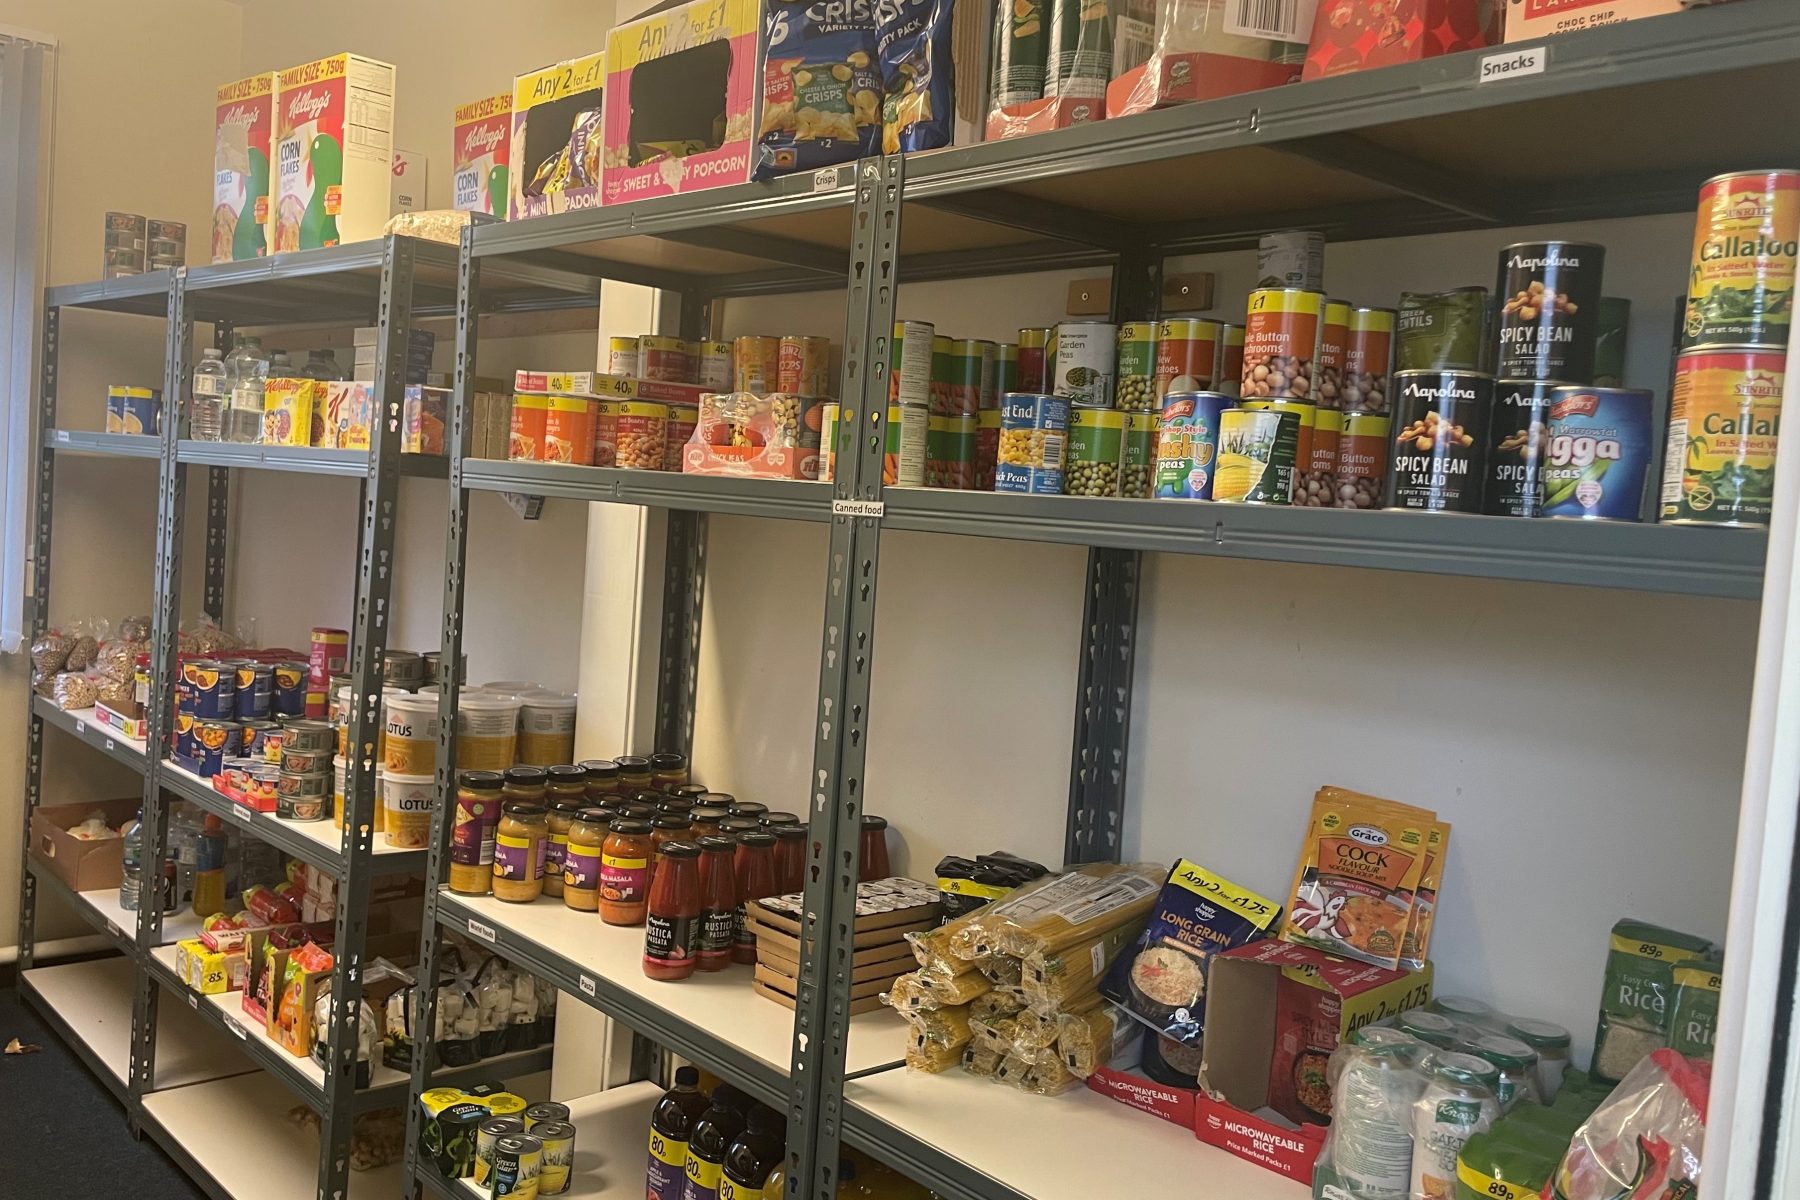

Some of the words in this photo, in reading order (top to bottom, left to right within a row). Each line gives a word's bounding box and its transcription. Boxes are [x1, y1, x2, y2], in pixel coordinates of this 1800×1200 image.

[690, 20, 705, 33] for
[707, 2, 727, 30] £1
[1557, 16, 1586, 30] CHOC
[1590, 11, 1615, 23] CHIP
[898, 18, 922, 38] PACK
[280, 71, 303, 87] FAMILY
[304, 62, 320, 82] SIZE
[326, 59, 345, 76] 750g
[1483, 55, 1535, 76] Snacks
[533, 76, 561, 99] Any
[563, 68, 573, 89] 2
[573, 75, 584, 85] for
[585, 59, 601, 83] £1
[217, 87, 236, 101] FAMILY
[237, 83, 252, 98] SIZE
[256, 78, 272, 92] 750g
[805, 89, 843, 103] CRISPS
[289, 90, 331, 119] Kellogg's
[455, 102, 478, 121] FAMILY
[479, 98, 494, 117] SIZE
[500, 94, 513, 111] 750
[224, 107, 260, 128] Kellogg's
[465, 124, 505, 150] Kellogg's
[281, 140, 301, 161] CORN
[281, 160, 299, 176] FLAKES
[693, 155, 746, 179] POPCORN
[217, 171, 232, 186] FLAKES
[457, 172, 479, 191] CORN
[623, 173, 652, 193] SWEET
[653, 172, 661, 186] &
[816, 174, 836, 187] Crisps
[457, 190, 478, 206] FLAKES
[530, 201, 547, 216] MINI
[1701, 235, 1798, 262] Callaloo
[1507, 249, 1580, 272] Napolina
[1717, 262, 1748, 271] Salted
[1752, 262, 1786, 270] Water
[1253, 295, 1266, 309] £1
[1256, 332, 1290, 342] Button
[1500, 326, 1534, 343] SPICY
[1537, 326, 1573, 342] BEAN
[715, 345, 729, 354] 40p
[1060, 341, 1086, 349] Garden
[1515, 343, 1551, 354] SALAD
[1060, 351, 1074, 359] Peas
[552, 378, 563, 390] 40p
[614, 381, 632, 395] 40p
[1403, 380, 1476, 402] Napolina
[1735, 384, 1782, 396] SUNRITE
[1013, 405, 1033, 418] End
[1184, 424, 1206, 433] Style
[1704, 413, 1780, 436] Callal
[1159, 433, 1214, 467] ushy
[1547, 436, 1620, 467] igga
[1729, 440, 1764, 448] Salted
[1160, 460, 1185, 472] peas
[1342, 453, 1375, 464] Button
[1395, 456, 1430, 472] SPICY
[1433, 457, 1468, 474] BEAN
[1007, 472, 1028, 483] Peas
[1411, 474, 1446, 486] SALAD
[1496, 465, 1535, 480] SPICY
[1546, 469, 1581, 482] peas
[1515, 483, 1544, 494] SALA
[835, 503, 863, 514] Canned
[865, 504, 882, 515] food
[399, 798, 433, 811] LOTUS
[1352, 829, 1384, 843] Grace
[1337, 844, 1390, 868] COCK
[1328, 864, 1355, 876] NOODLE
[1356, 869, 1372, 879] SOUP
[1339, 858, 1381, 873] FLAVOUR
[1180, 871, 1209, 887] Any
[1207, 883, 1220, 893] 2
[1217, 890, 1231, 900] for
[1231, 897, 1269, 915] £1.75
[1195, 907, 1215, 919] shopper
[1200, 902, 1218, 914] happy
[470, 923, 483, 934] World
[483, 927, 494, 939] foods
[648, 927, 672, 939] USTICA
[705, 921, 733, 931] RUSTICA
[1161, 910, 1193, 930] LONG
[1194, 925, 1231, 947] GRAIN
[648, 936, 668, 946] PASSATA
[1177, 930, 1204, 947] RICE
[1639, 944, 1662, 958] 89p
[581, 979, 594, 992] Pasta
[1624, 974, 1641, 985] Easy
[1620, 985, 1665, 1013] Rice
[1345, 1009, 1375, 1039] Any
[1375, 1001, 1386, 1022] 2
[1385, 1007, 1396, 1017] for
[1397, 983, 1429, 1014] £1.75
[1691, 1010, 1712, 1022] Easy
[1108, 1079, 1178, 1103] MICROWAVEABLE
[1134, 1093, 1153, 1105] RICE
[1147, 1106, 1163, 1116] Packs
[1225, 1121, 1304, 1153] MICROWAVEABLE
[651, 1136, 666, 1157] 80p
[1253, 1139, 1274, 1154] RICE
[497, 1157, 516, 1167] Green
[1227, 1140, 1241, 1151] Price
[1242, 1145, 1264, 1161] Marked
[1265, 1154, 1282, 1169] Packs
[1283, 1163, 1291, 1171] £1
[687, 1157, 701, 1178] 80p
[1488, 1183, 1514, 1200] 89p
